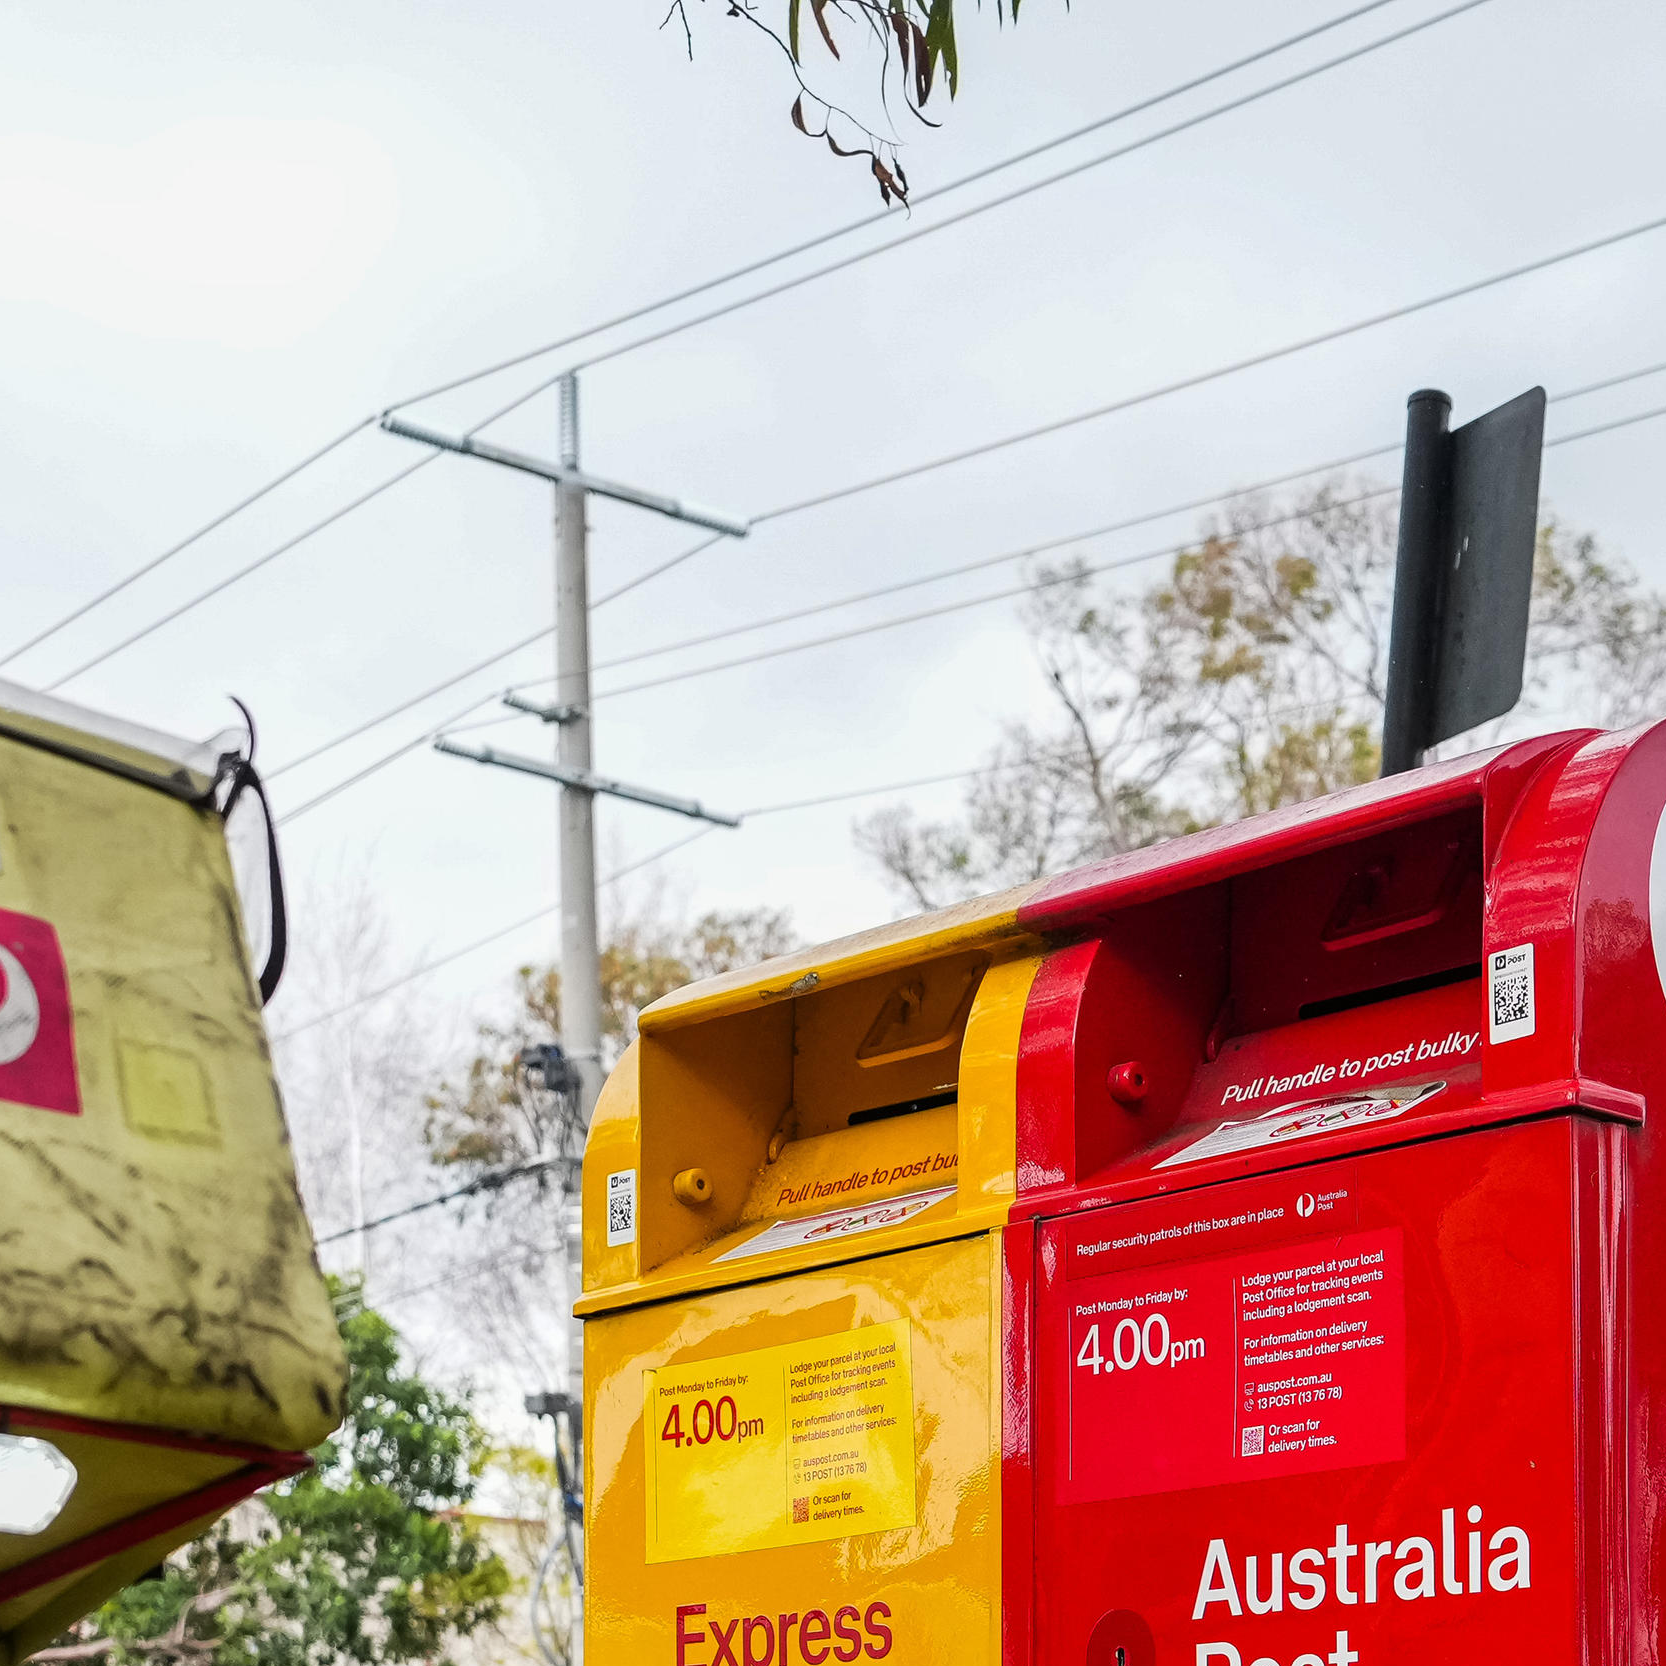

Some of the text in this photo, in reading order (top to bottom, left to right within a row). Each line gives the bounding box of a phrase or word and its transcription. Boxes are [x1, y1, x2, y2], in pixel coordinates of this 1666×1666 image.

[1221, 1031, 1480, 1105] Pull handle to post bulky
[777, 1183, 811, 1206] Pull
[811, 1171, 868, 1199] handle
[871, 1168, 888, 1185] to
[888, 1156, 931, 1185] post
[1317, 1189, 1348, 1202] Australia
[1317, 1202, 1333, 1211] Post
[1077, 1207, 1284, 1256] Regular security patrols of this box are in place
[1242, 1250, 1384, 1287] Lodge your parcel at your local
[1242, 1269, 1383, 1304] Post Office for tracking events
[1076, 1288, 1188, 1316] Post Monday to Friday by:
[1243, 1290, 1372, 1321] including a lodgement scan.
[1244, 1321, 1368, 1350] For information on delivery
[790, 1342, 896, 1373] Lodge your parcel at your local
[1244, 1335, 1384, 1366] timetables and other services:
[791, 1359, 895, 1389] Post Office for tracking events
[1257, 1372, 1332, 1392] auspost.com.au
[660, 1386, 675, 1396] Post
[677, 1382, 705, 1394] Monday
[707, 1380, 713, 1389] to
[715, 1377, 736, 1388] Friday
[791, 1390, 823, 1403] including
[830, 1380, 868, 1396] lodgement
[1258, 1386, 1343, 1410] 13 POST (13 76 78)
[792, 1404, 884, 1429] For information on delivery
[1269, 1419, 1320, 1436] Or scan for
[793, 1429, 830, 1444] timetables
[831, 1425, 844, 1436] and
[846, 1422, 864, 1433] other
[1268, 1435, 1337, 1453] delivery times.
[803, 1450, 859, 1467] auspost.com.au
[804, 1462, 867, 1482] 13 POST (13 76 78)
[813, 1491, 851, 1505] Or scan for
[813, 1509, 842, 1520] delivery
[1191, 1504, 1531, 1620] Australia
